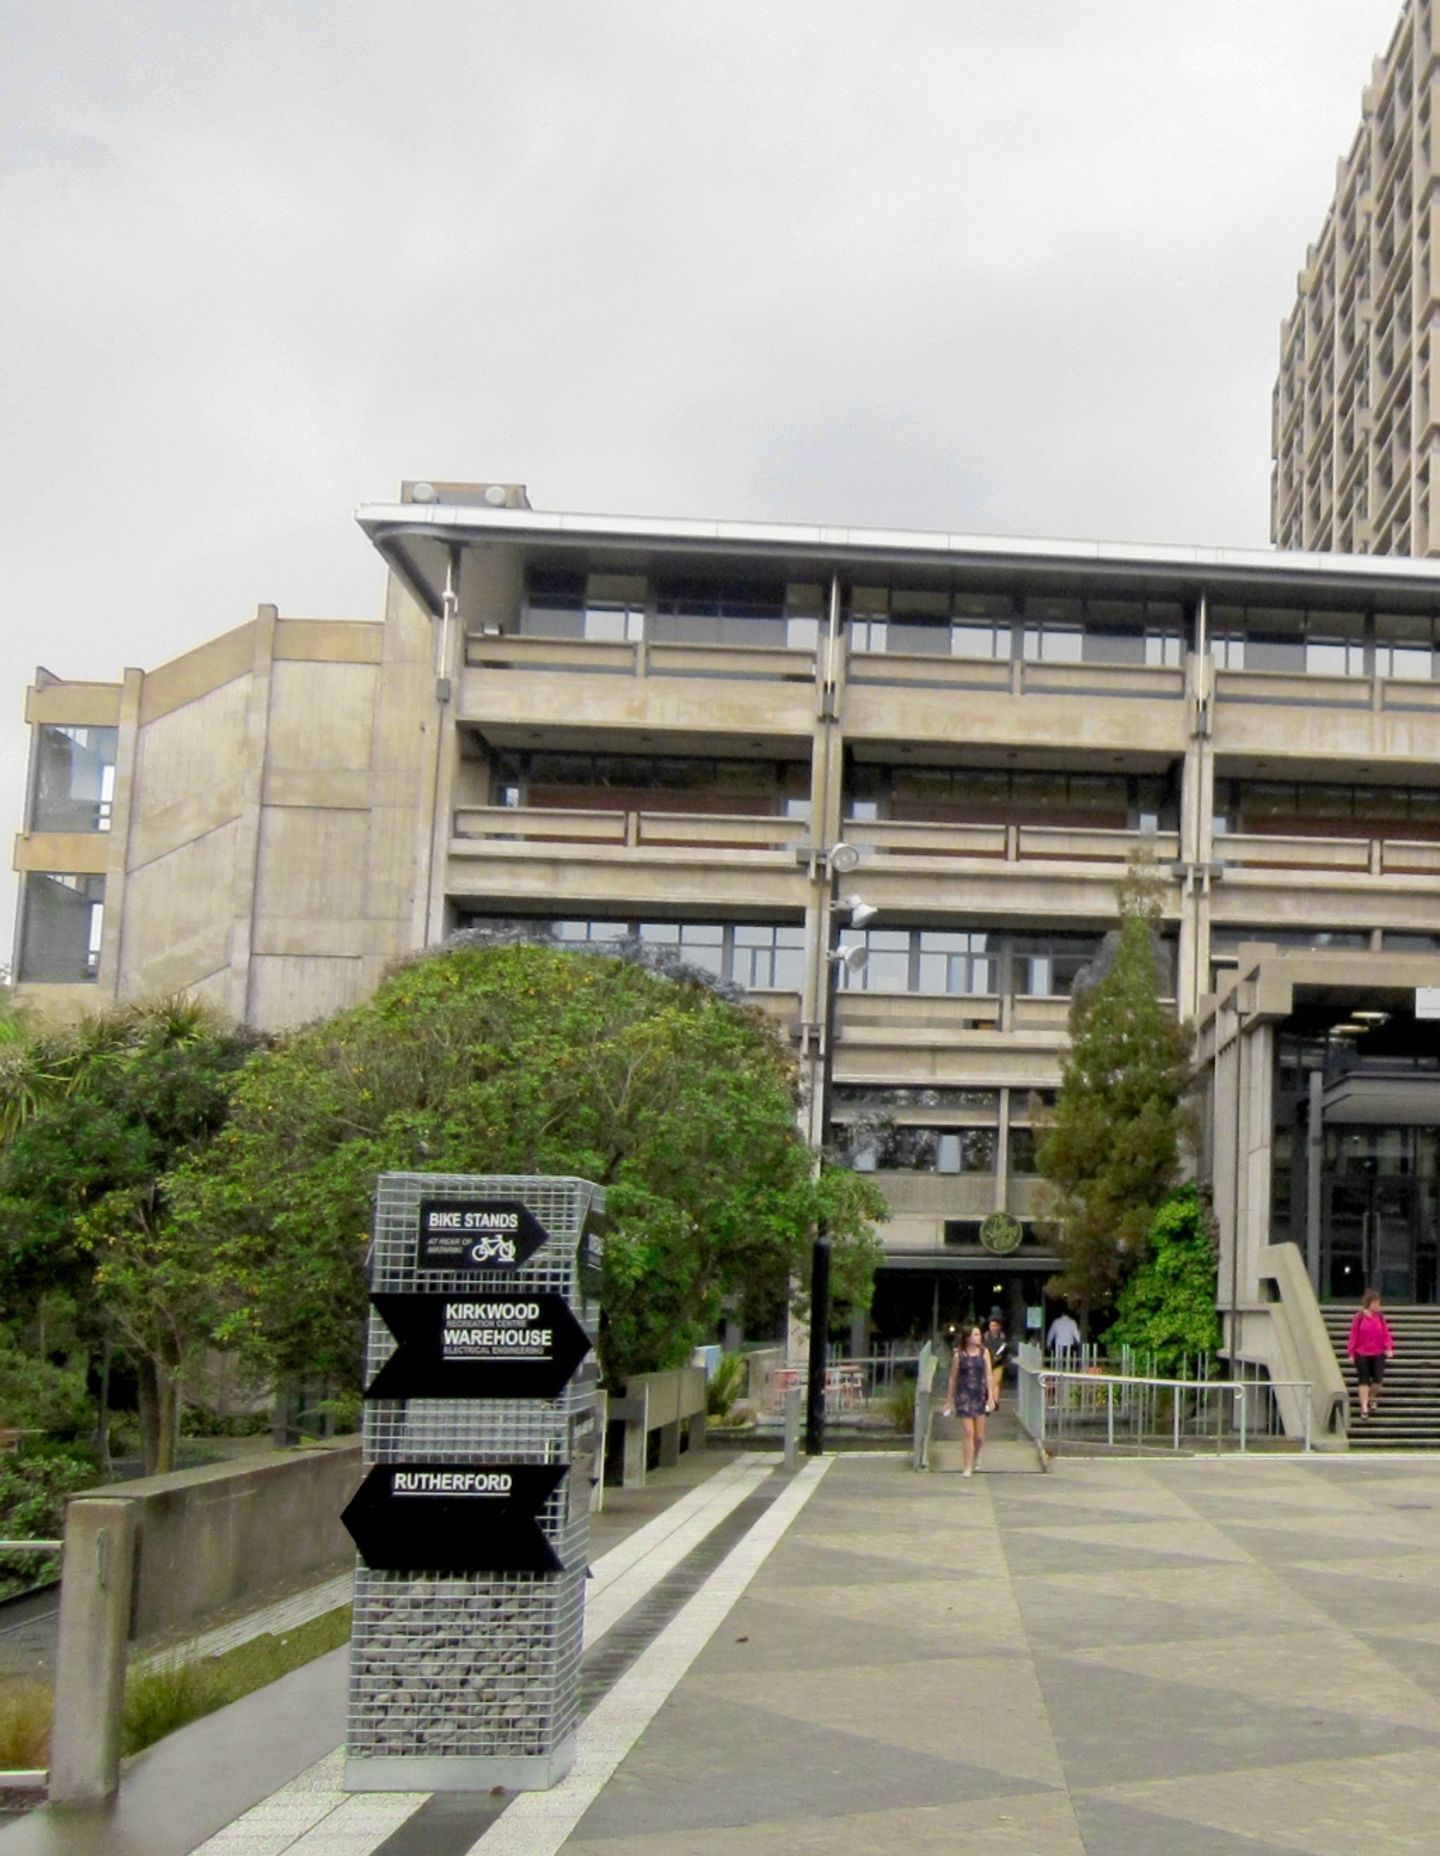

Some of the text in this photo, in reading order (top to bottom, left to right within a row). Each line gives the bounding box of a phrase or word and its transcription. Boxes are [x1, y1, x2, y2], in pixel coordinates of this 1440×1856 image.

[429, 1212, 518, 1228] BIKE STANDS
[446, 1303, 540, 1320] KIRKWOOD
[444, 1329, 553, 1346] WAREHOUSE
[444, 1346, 490, 1355] ELECTRICAL
[395, 1473, 512, 1490] RUTHERFORD
